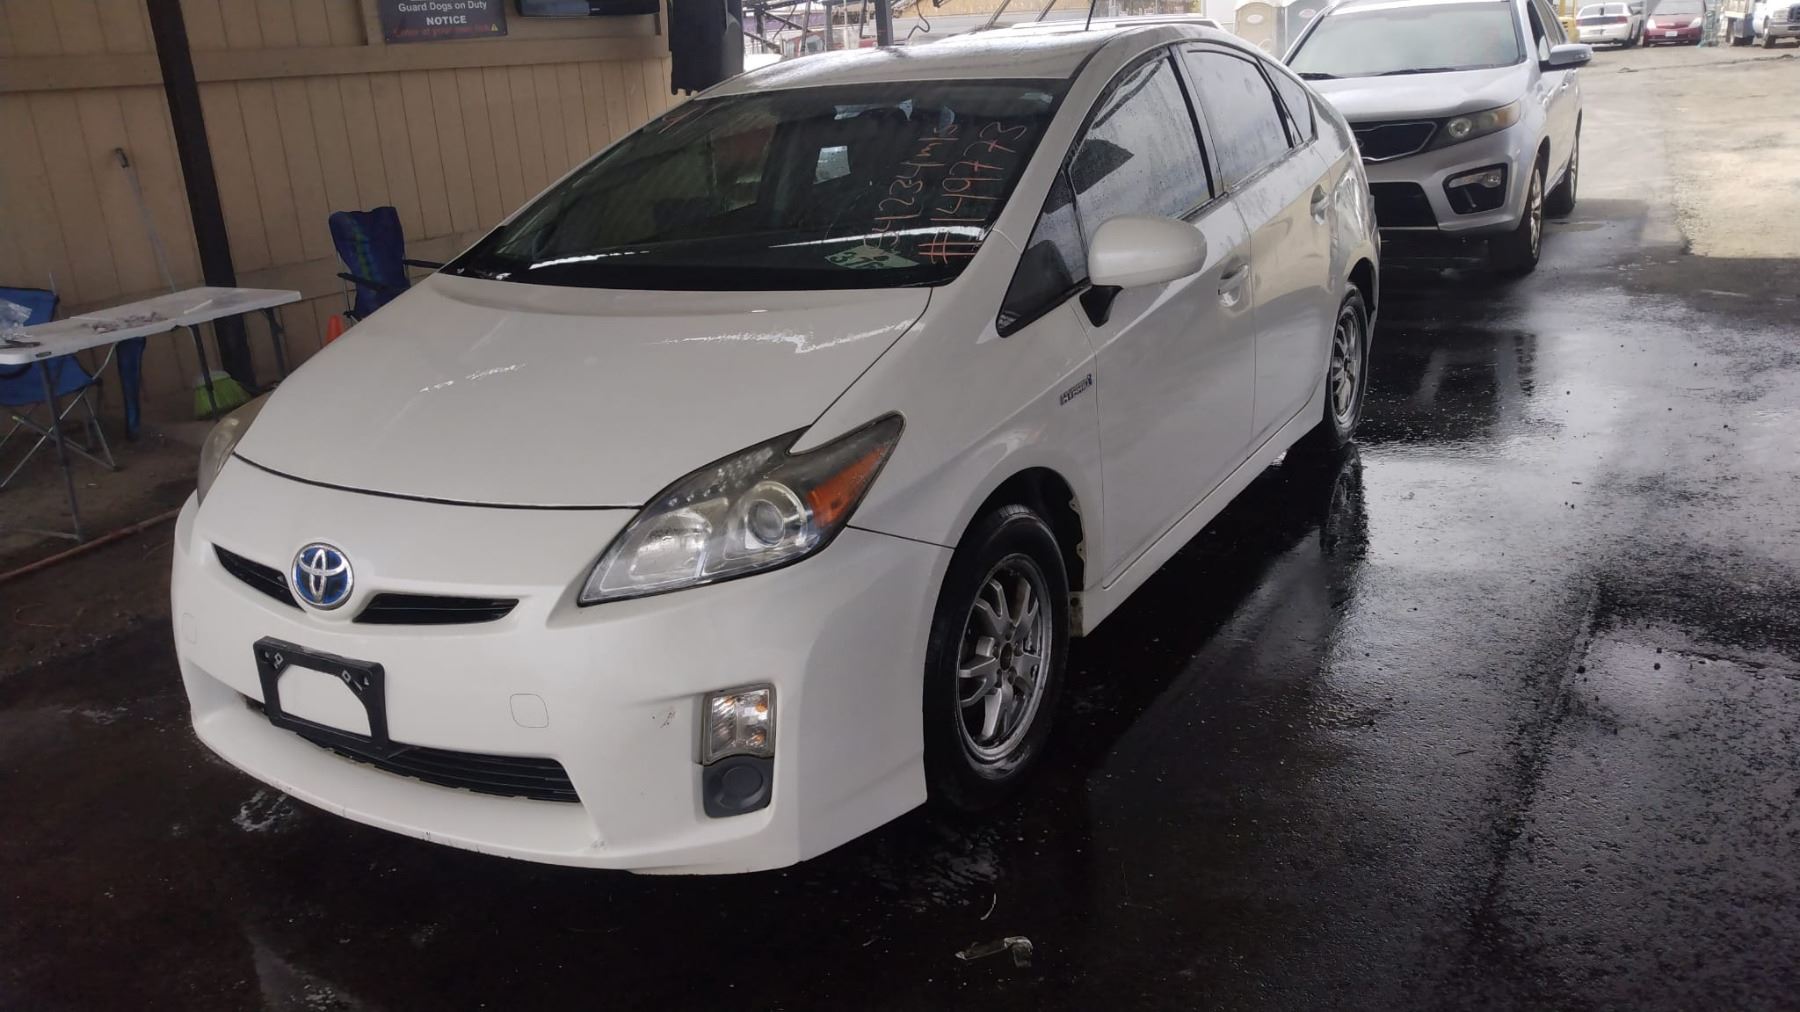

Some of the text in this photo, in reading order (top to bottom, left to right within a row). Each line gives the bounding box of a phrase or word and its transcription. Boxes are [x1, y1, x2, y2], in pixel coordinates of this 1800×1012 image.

[398, 0, 487, 12] Guard Dogs on Duty
[426, 15, 467, 26] NOTICE
